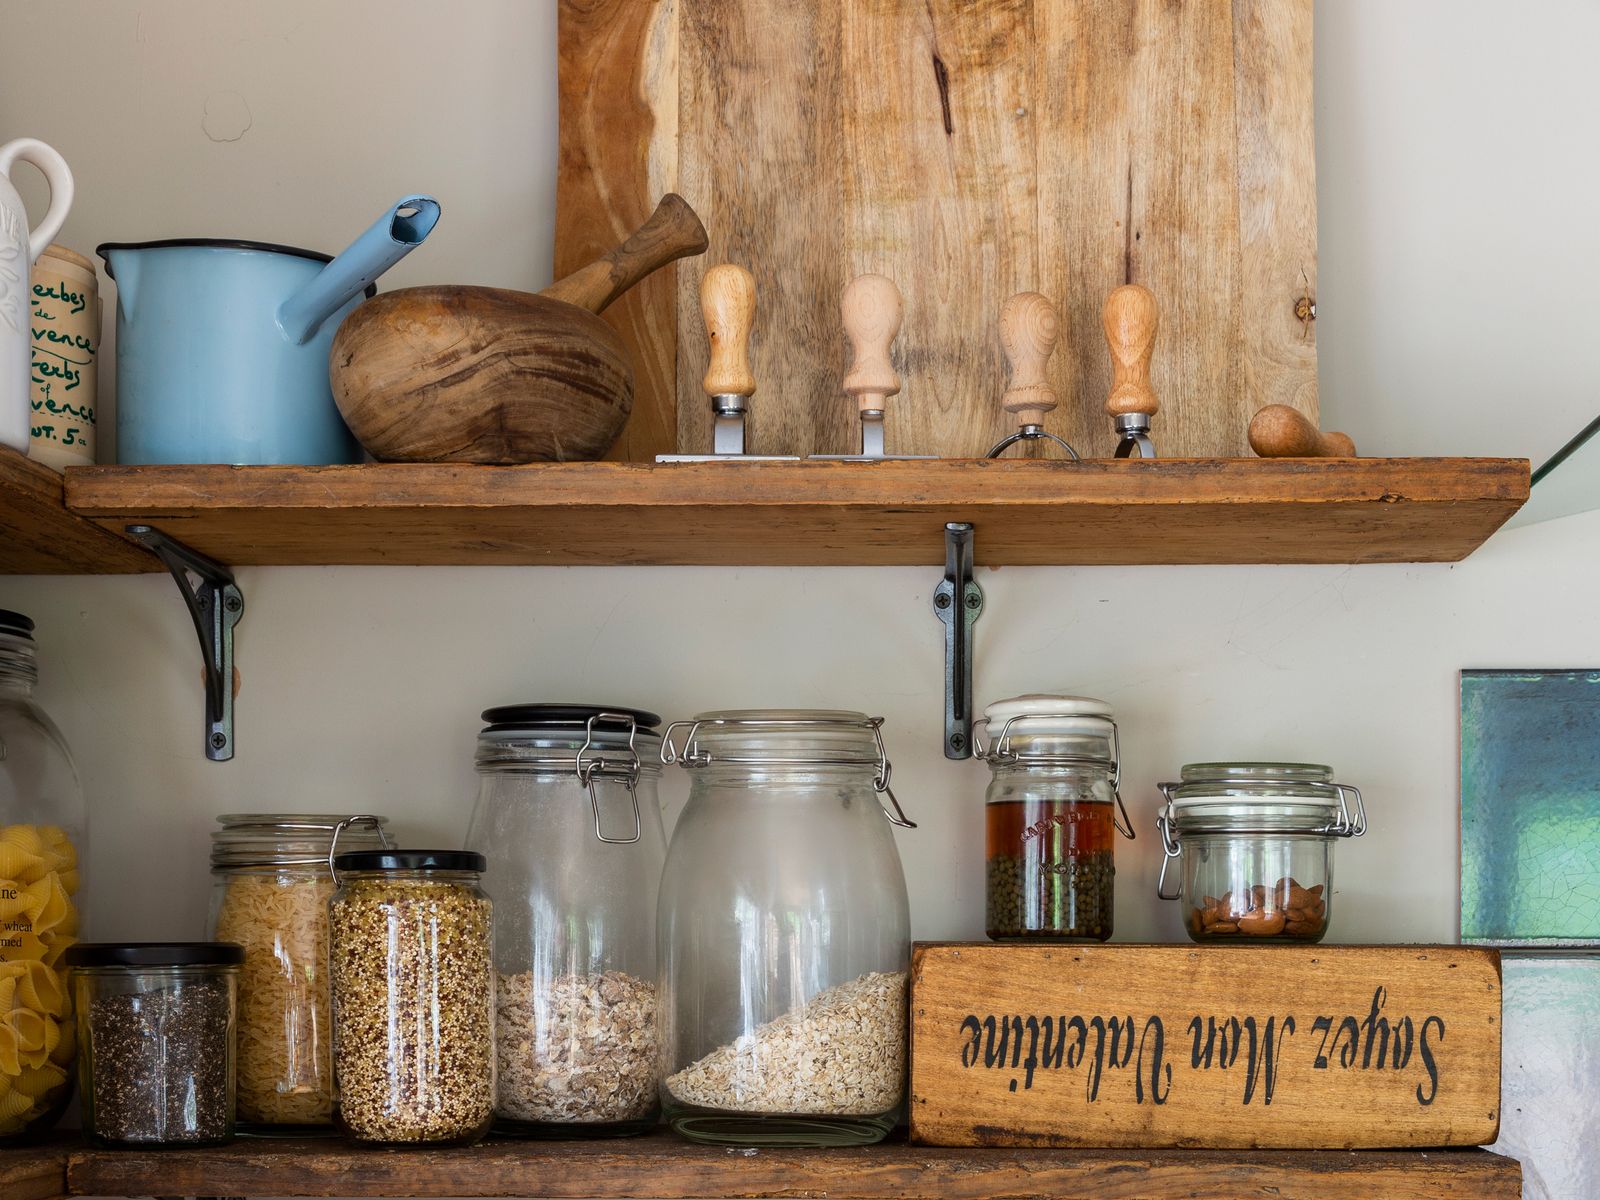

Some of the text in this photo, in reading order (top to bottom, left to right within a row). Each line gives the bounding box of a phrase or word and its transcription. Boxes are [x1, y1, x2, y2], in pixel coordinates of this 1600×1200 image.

[32, 281, 86, 315] erbes
[34, 308, 56, 320] de
[40, 383, 51, 400] of
[62, 428, 80, 445] 5
[4, 921, 32, 932] wheat
[960, 986, 1444, 1105] Soyez Mon Valentine
